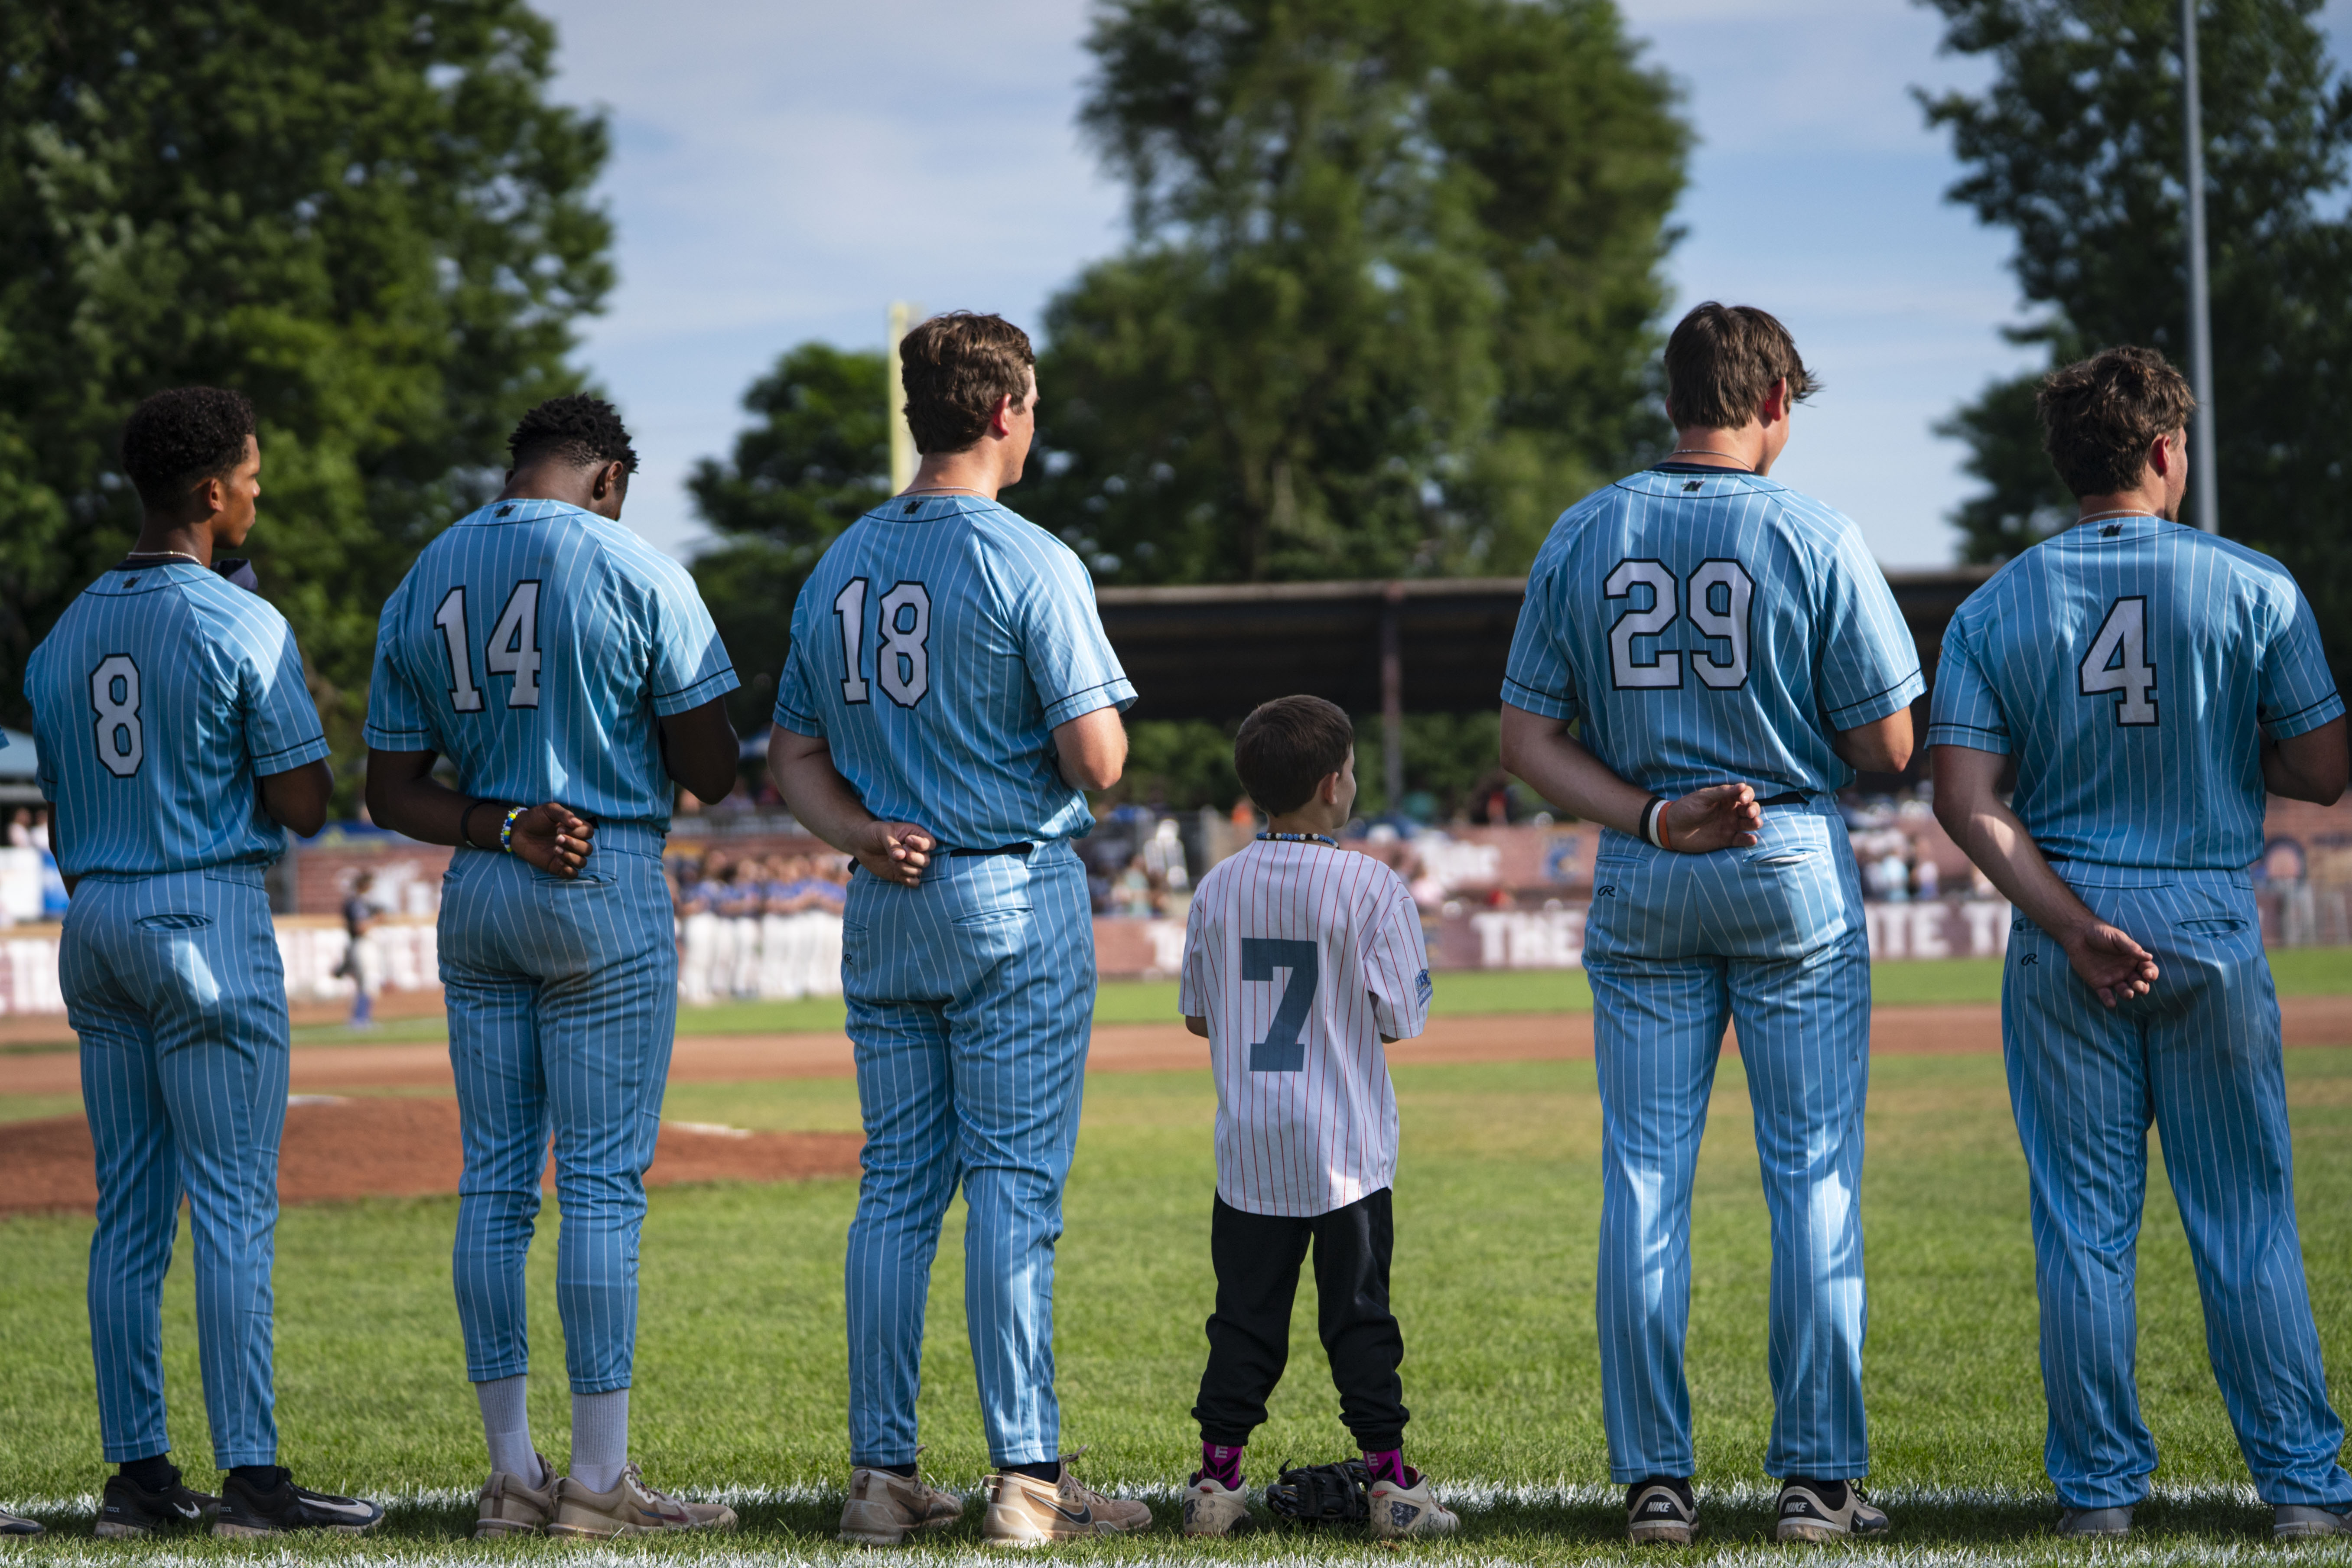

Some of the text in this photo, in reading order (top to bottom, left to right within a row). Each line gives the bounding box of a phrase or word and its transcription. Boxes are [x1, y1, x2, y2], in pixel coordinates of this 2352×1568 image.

[434, 579, 542, 714] 14
[833, 576, 932, 710] 18
[1603, 558, 1757, 691] 29
[2078, 595, 2160, 727] 4
[89, 653, 144, 779] 8
[1241, 937, 1319, 1072] 7
[1646, 1502, 1671, 1513] NIKE
[1785, 1502, 1808, 1514] NIKE
